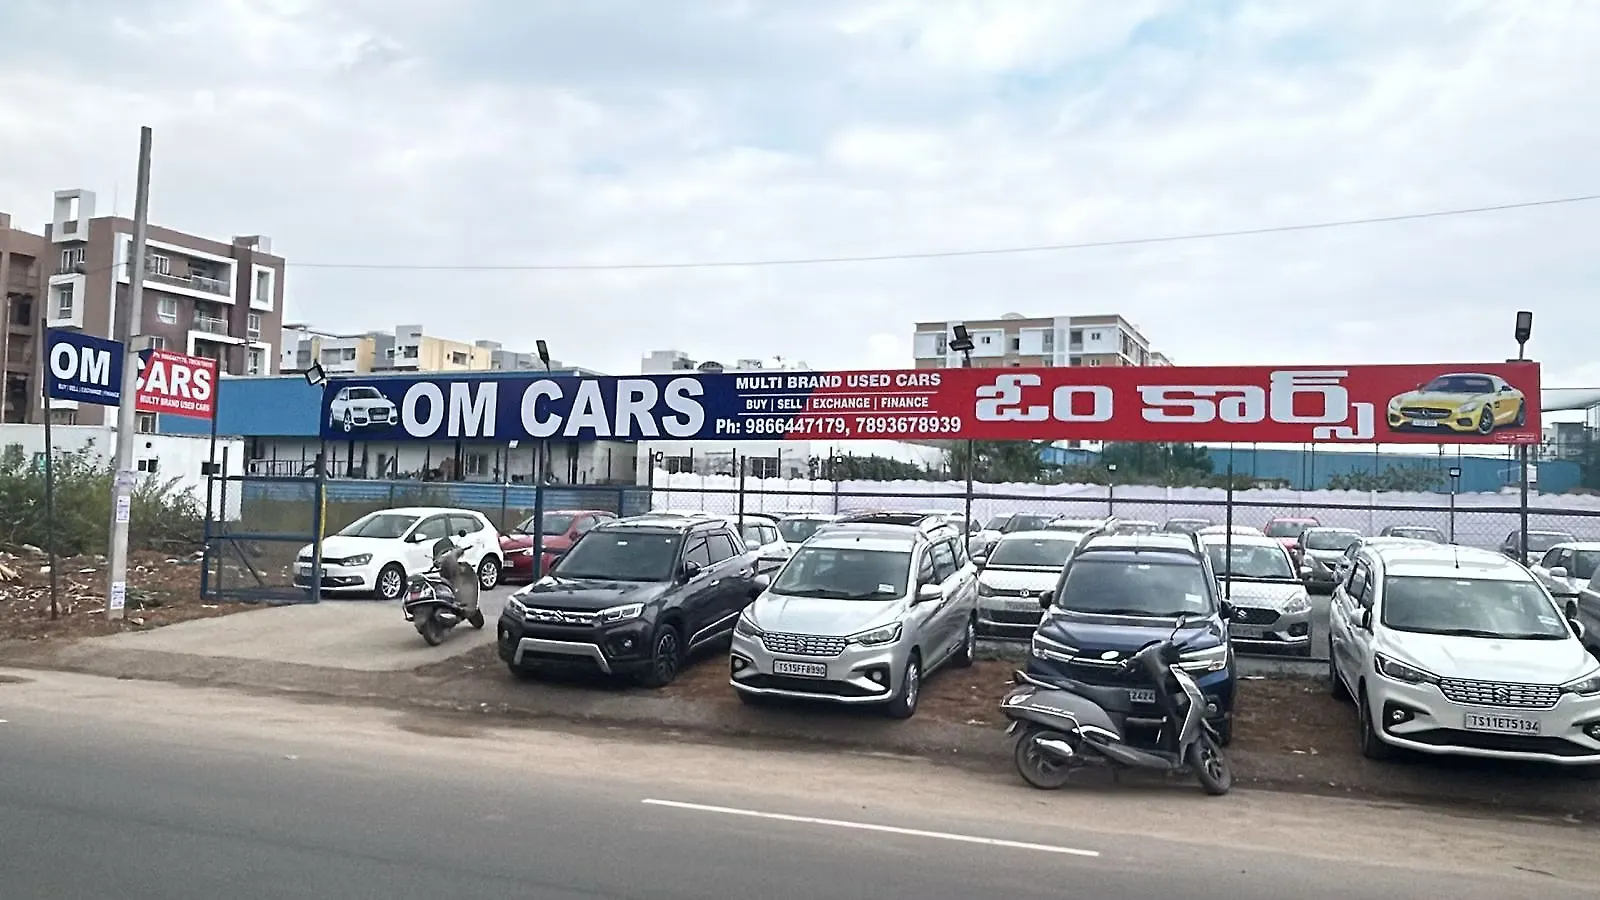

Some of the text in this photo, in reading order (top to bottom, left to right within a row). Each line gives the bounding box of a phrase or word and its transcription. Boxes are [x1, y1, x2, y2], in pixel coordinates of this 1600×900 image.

[50, 342, 111, 386] OM
[736, 373, 941, 389] MULTI BRAND USED CARS
[746, 398, 768, 410] BUY
[777, 398, 803, 410] SELL
[813, 397, 871, 409] EXCHANGE
[881, 397, 929, 408] FINANCE
[975, 373, 1114, 422] ఓం
[401, 378, 706, 438] OM CARS
[716, 416, 962, 436] Ph: 9866447179, 7893678939
[1472, 715, 1539, 731] TS11ET5134
